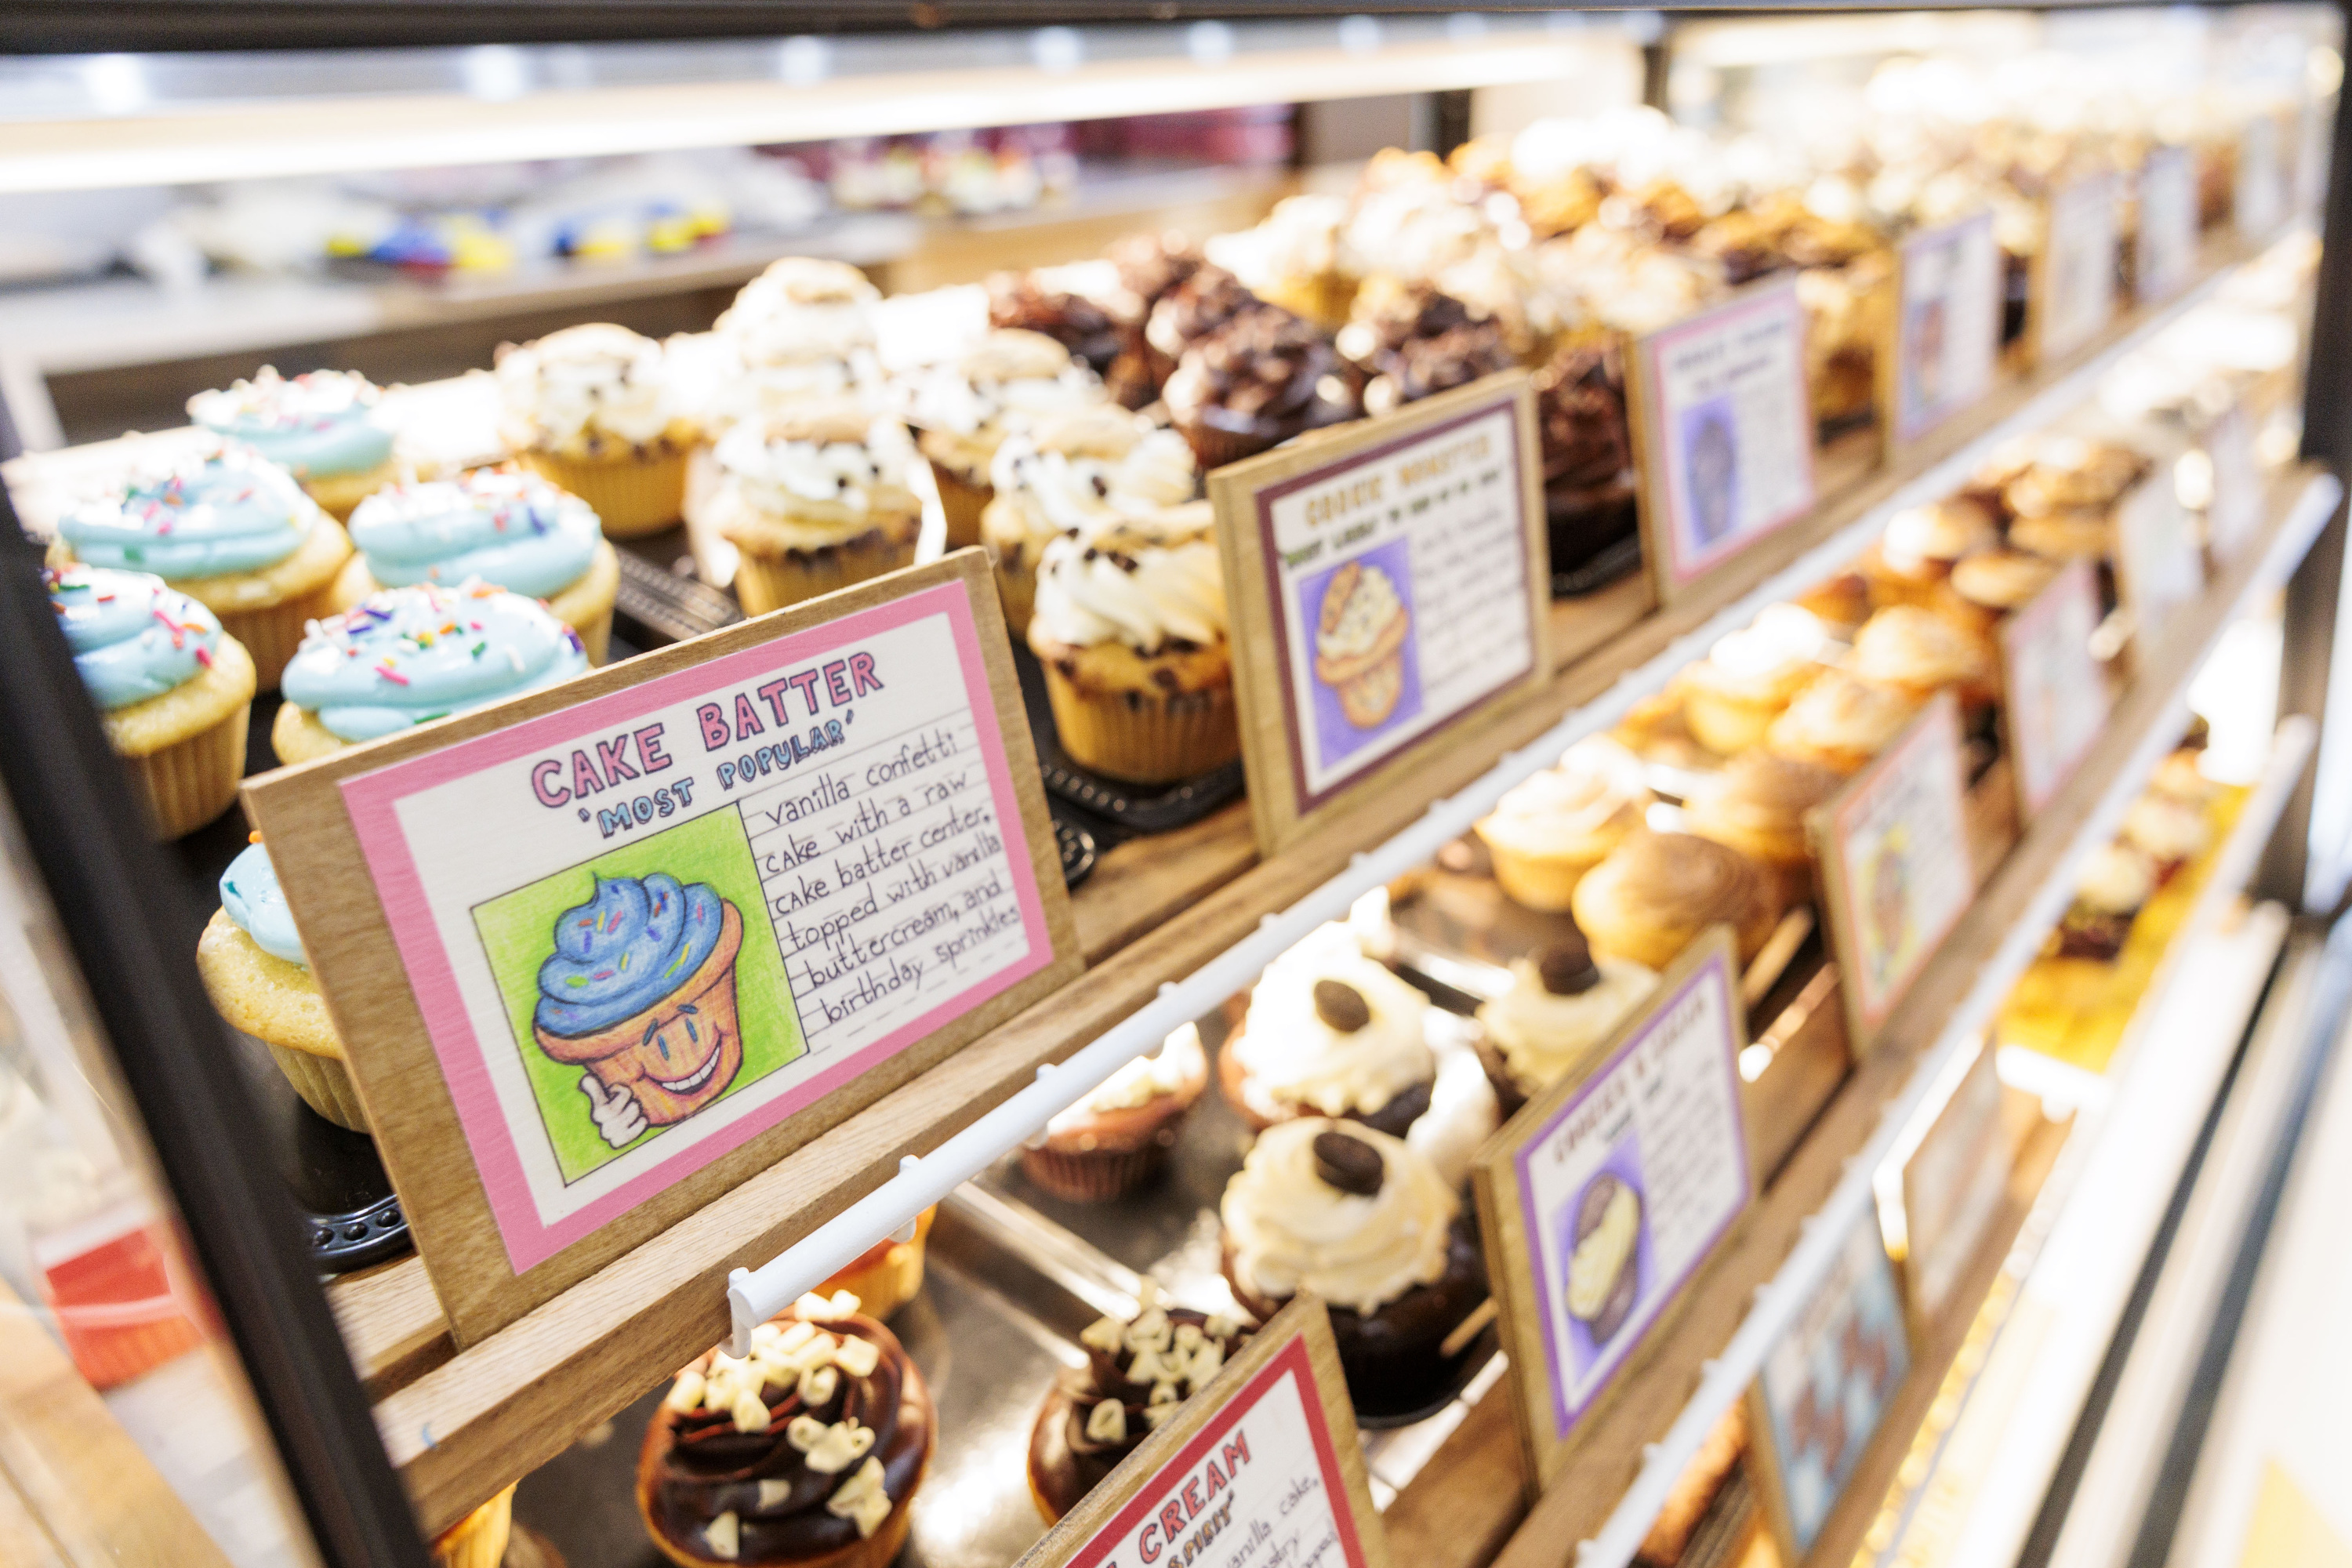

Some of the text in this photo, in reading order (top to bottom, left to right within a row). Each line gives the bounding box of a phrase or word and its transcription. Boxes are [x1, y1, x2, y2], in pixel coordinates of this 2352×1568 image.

[531, 652, 884, 808] CAKE BATTER
[766, 728, 959, 825] vanilla confetti
[836, 797, 888, 844] with
[898, 796, 911, 816] a
[924, 771, 967, 806] raw
[836, 838, 913, 888] batter
[787, 832, 1002, 951] topped with vanilla
[805, 868, 1003, 989] buttercream, and
[820, 905, 1020, 1024] birthday sprinkles
[1139, 1429, 1251, 1565] CREAM
